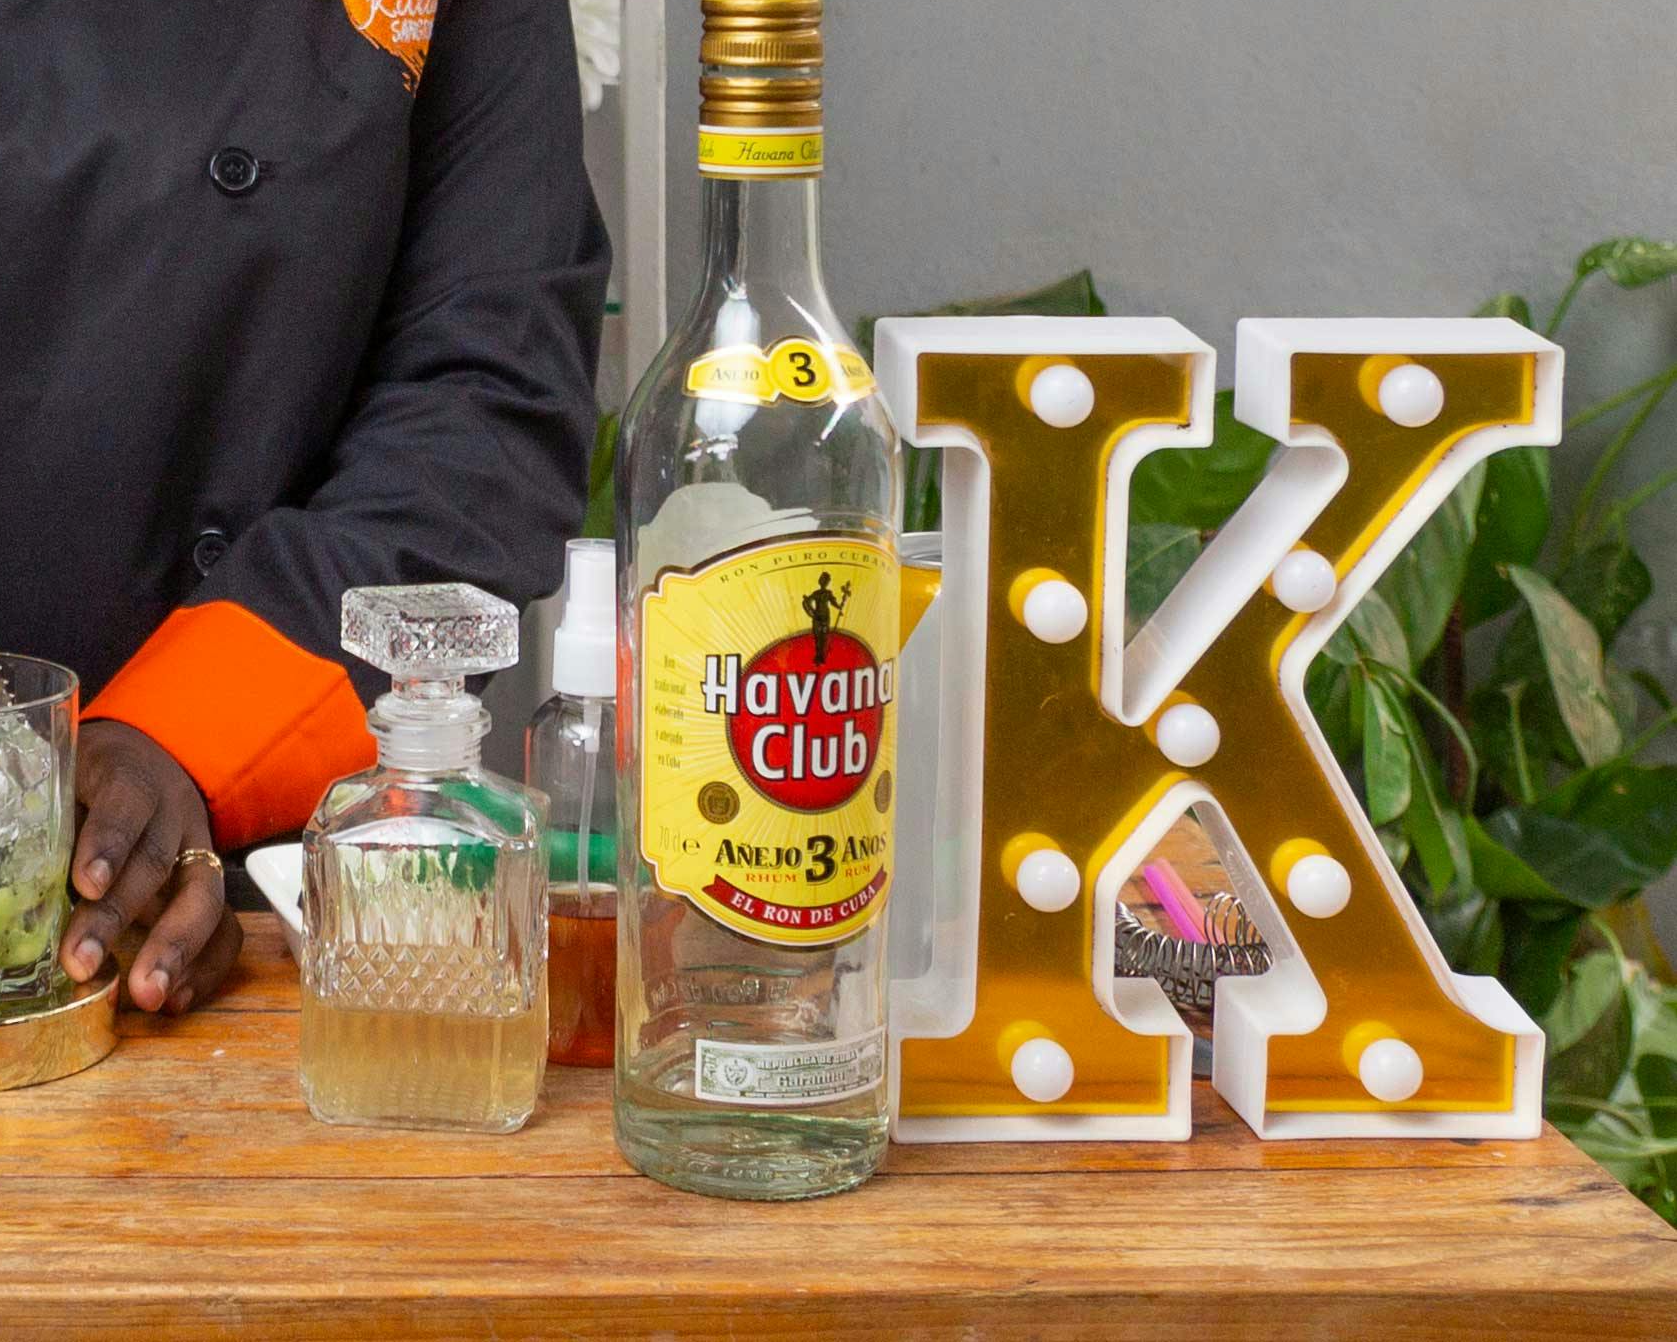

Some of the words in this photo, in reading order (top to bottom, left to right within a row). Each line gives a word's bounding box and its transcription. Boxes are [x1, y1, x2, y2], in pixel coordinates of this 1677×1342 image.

[733, 141, 794, 161] Havana
[789, 352, 816, 387] 3
[720, 562, 759, 584] RON
[773, 551, 828, 566] PURO
[700, 653, 895, 715] Havana
[751, 718, 869, 781] Club
[715, 837, 802, 871] AÑEJO
[806, 834, 838, 886] 3
[842, 832, 888, 865] AÑOS
[746, 872, 798, 884] RHUM
[845, 864, 872, 879] RUM
[730, 890, 755, 916] EL
[763, 905, 802, 925] RON
[810, 904, 835, 924] DE
[839, 883, 878, 917] CUBA
